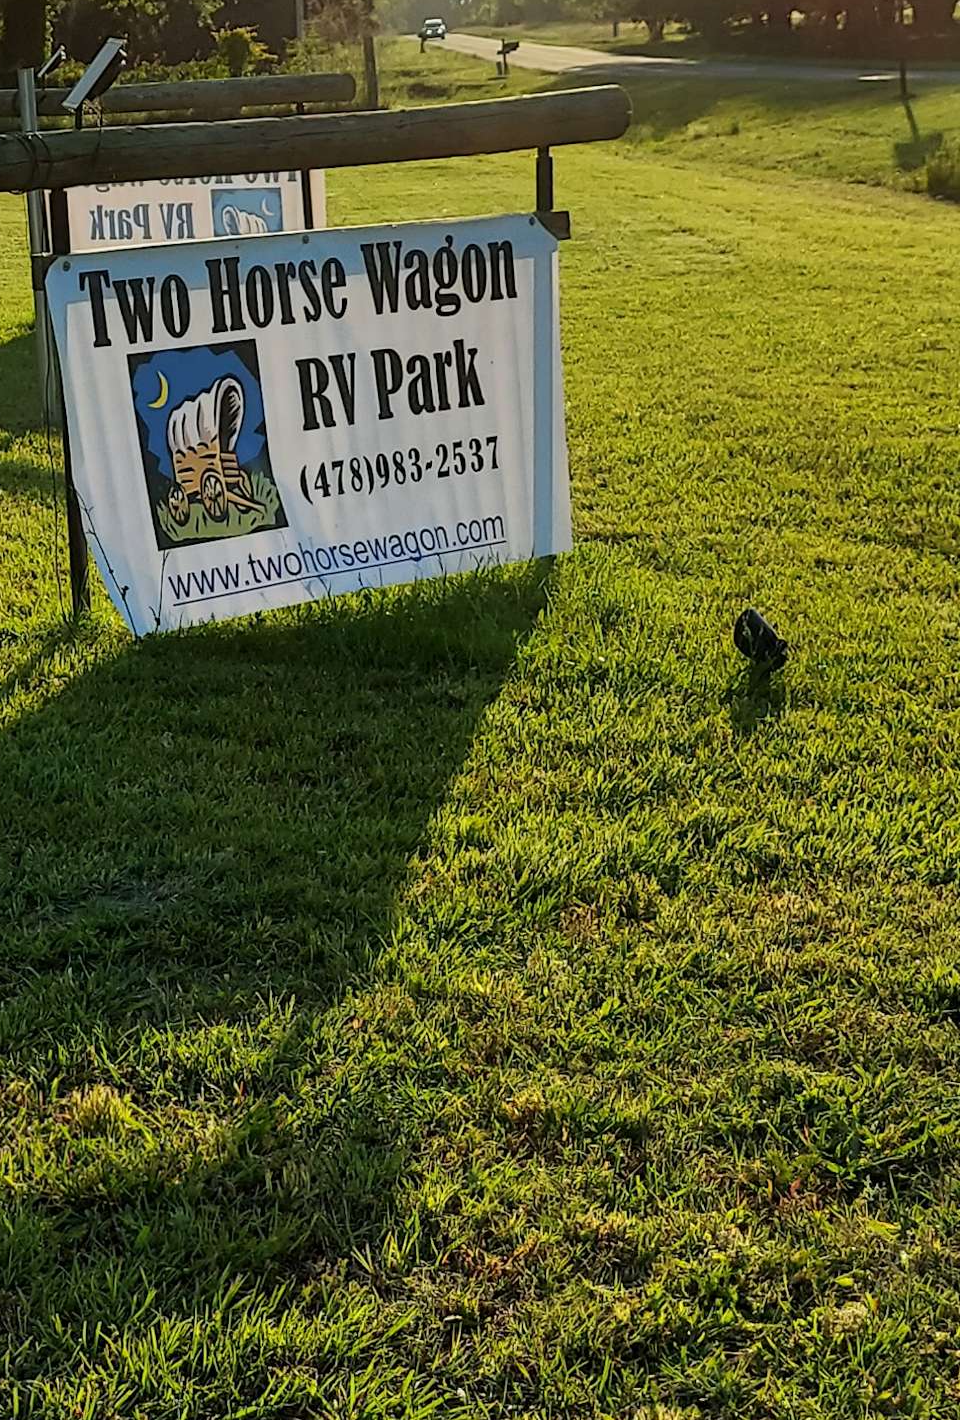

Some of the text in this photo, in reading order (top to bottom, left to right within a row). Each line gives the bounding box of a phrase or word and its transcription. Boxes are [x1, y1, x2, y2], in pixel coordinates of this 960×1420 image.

[79, 235, 518, 348] Two Horse Wagon
[295, 339, 486, 431] RV Park
[299, 436, 500, 505] (478)983-2537
[168, 513, 505, 600] www.twohorsewagon.com
